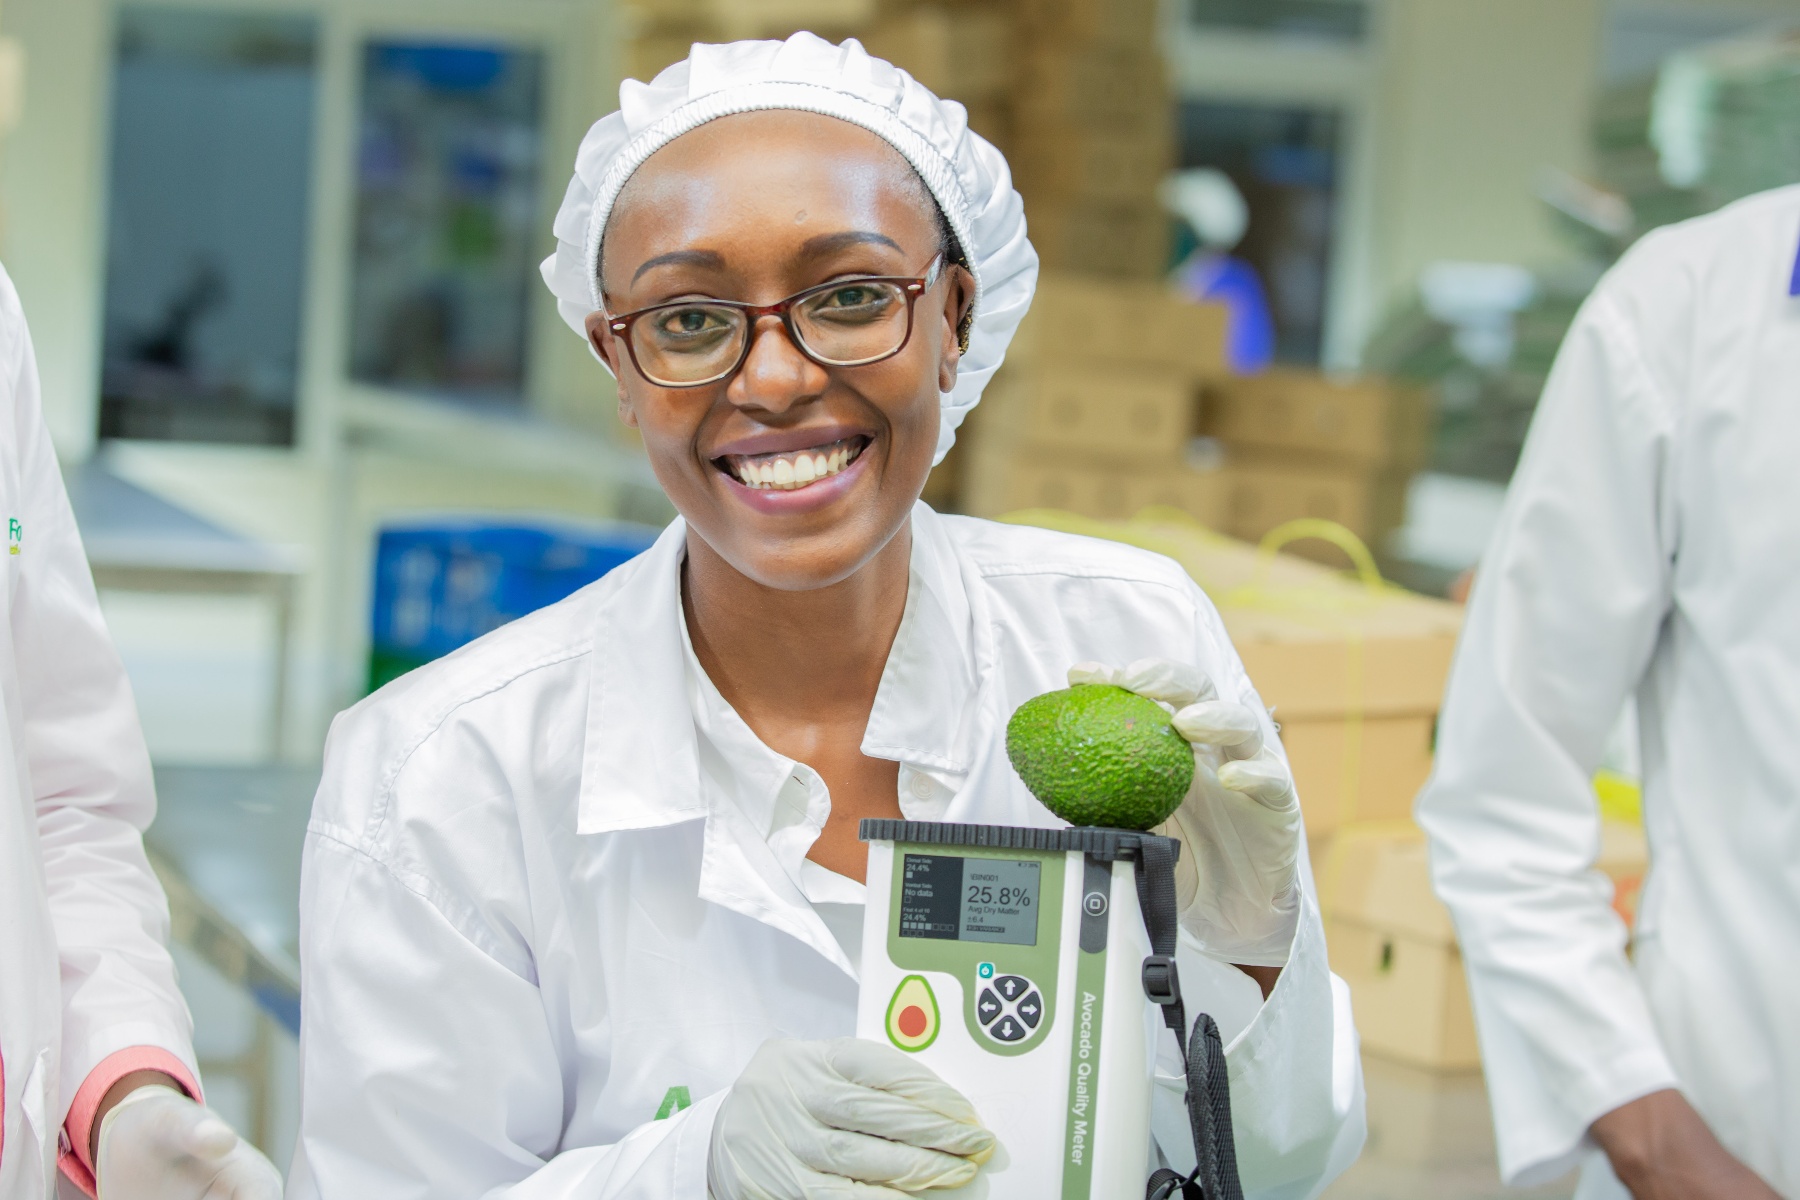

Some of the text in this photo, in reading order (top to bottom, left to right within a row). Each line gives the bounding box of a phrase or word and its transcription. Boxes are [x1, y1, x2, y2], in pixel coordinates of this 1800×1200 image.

[906, 864, 930, 872] 24.4%
[917, 889, 934, 898] data
[967, 885, 1031, 907] 25.8%
[968, 905, 1020, 915] Avg Dry Matter
[903, 913, 927, 922] 24.4%
[1071, 991, 1097, 1166] Avocado Quality Meter
[653, 1086, 692, 1121] A
